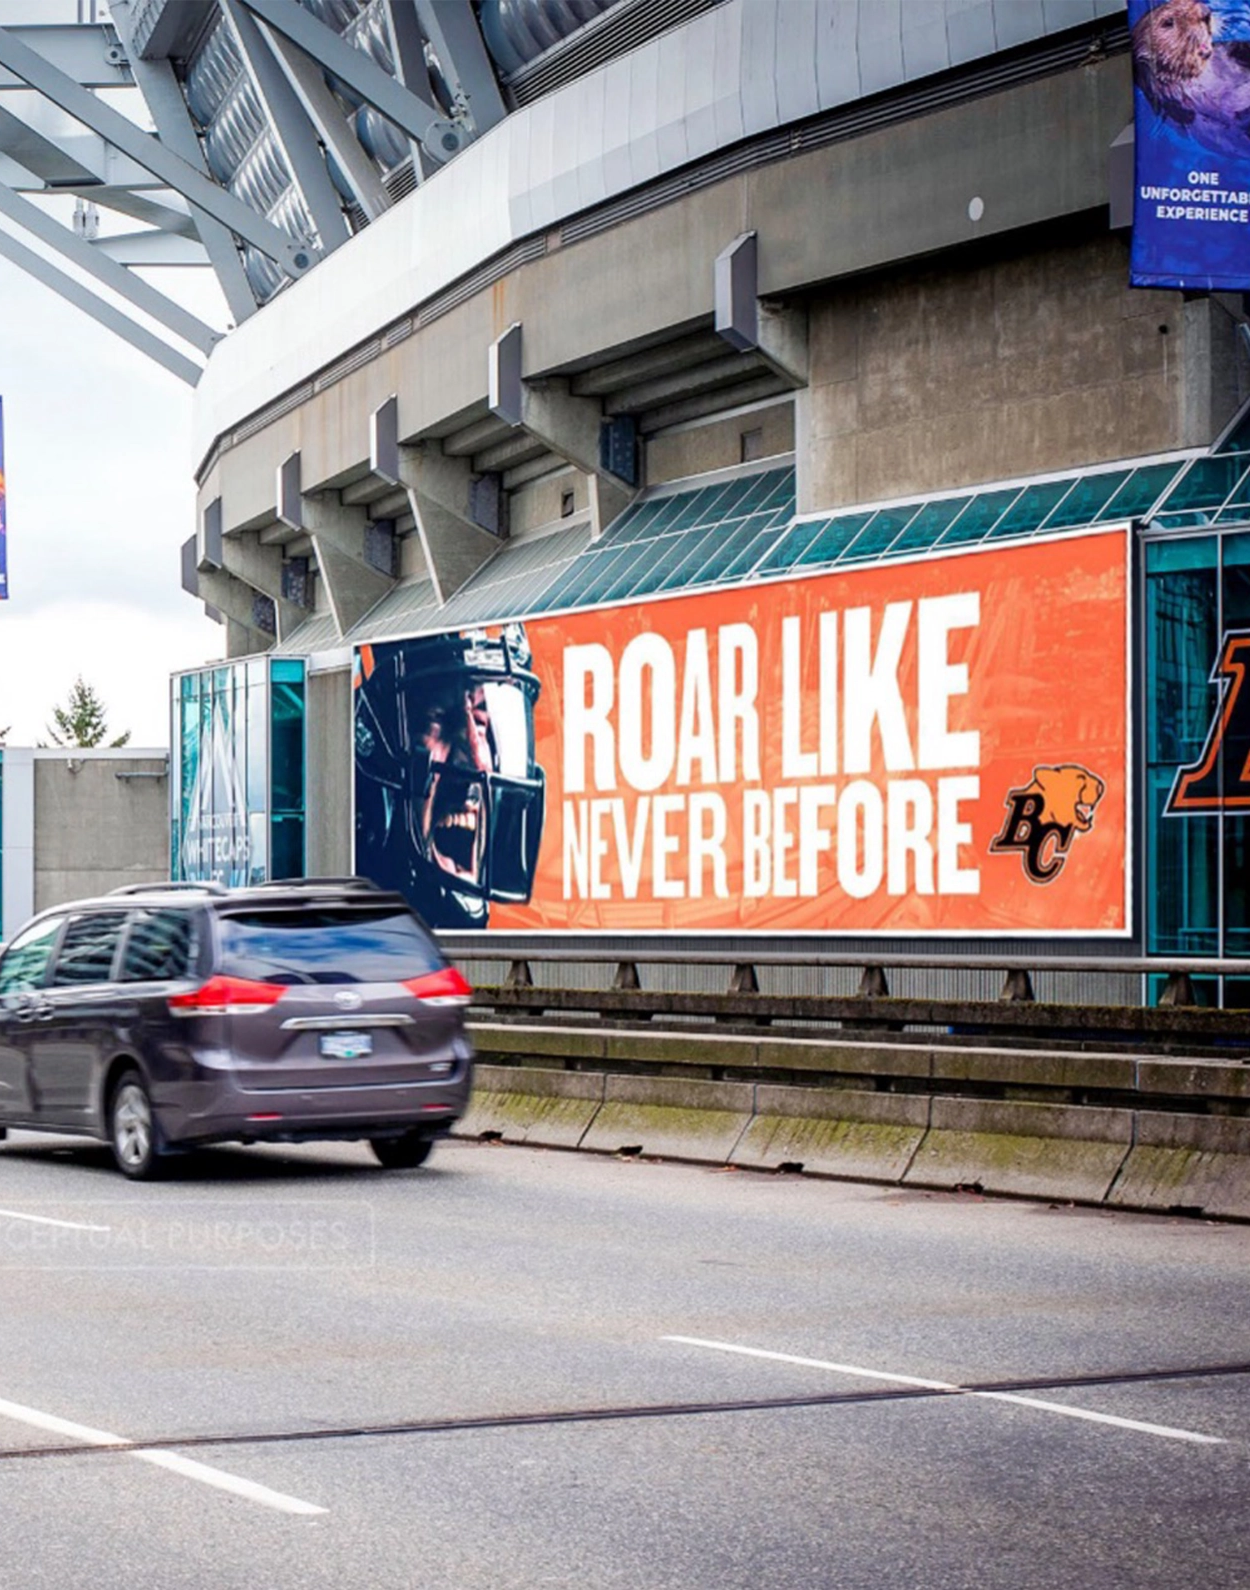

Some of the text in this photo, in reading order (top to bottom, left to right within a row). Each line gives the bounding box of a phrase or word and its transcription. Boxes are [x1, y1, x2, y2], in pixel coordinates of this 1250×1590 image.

[1188, 171, 1219, 185] ONE
[1141, 186, 1250, 204] UNFORGETTAB
[1156, 206, 1248, 222] EXPERIENCE
[563, 622, 760, 793] ROAR
[782, 591, 980, 778] LIKE
[562, 775, 980, 900] NEVER BEFORE
